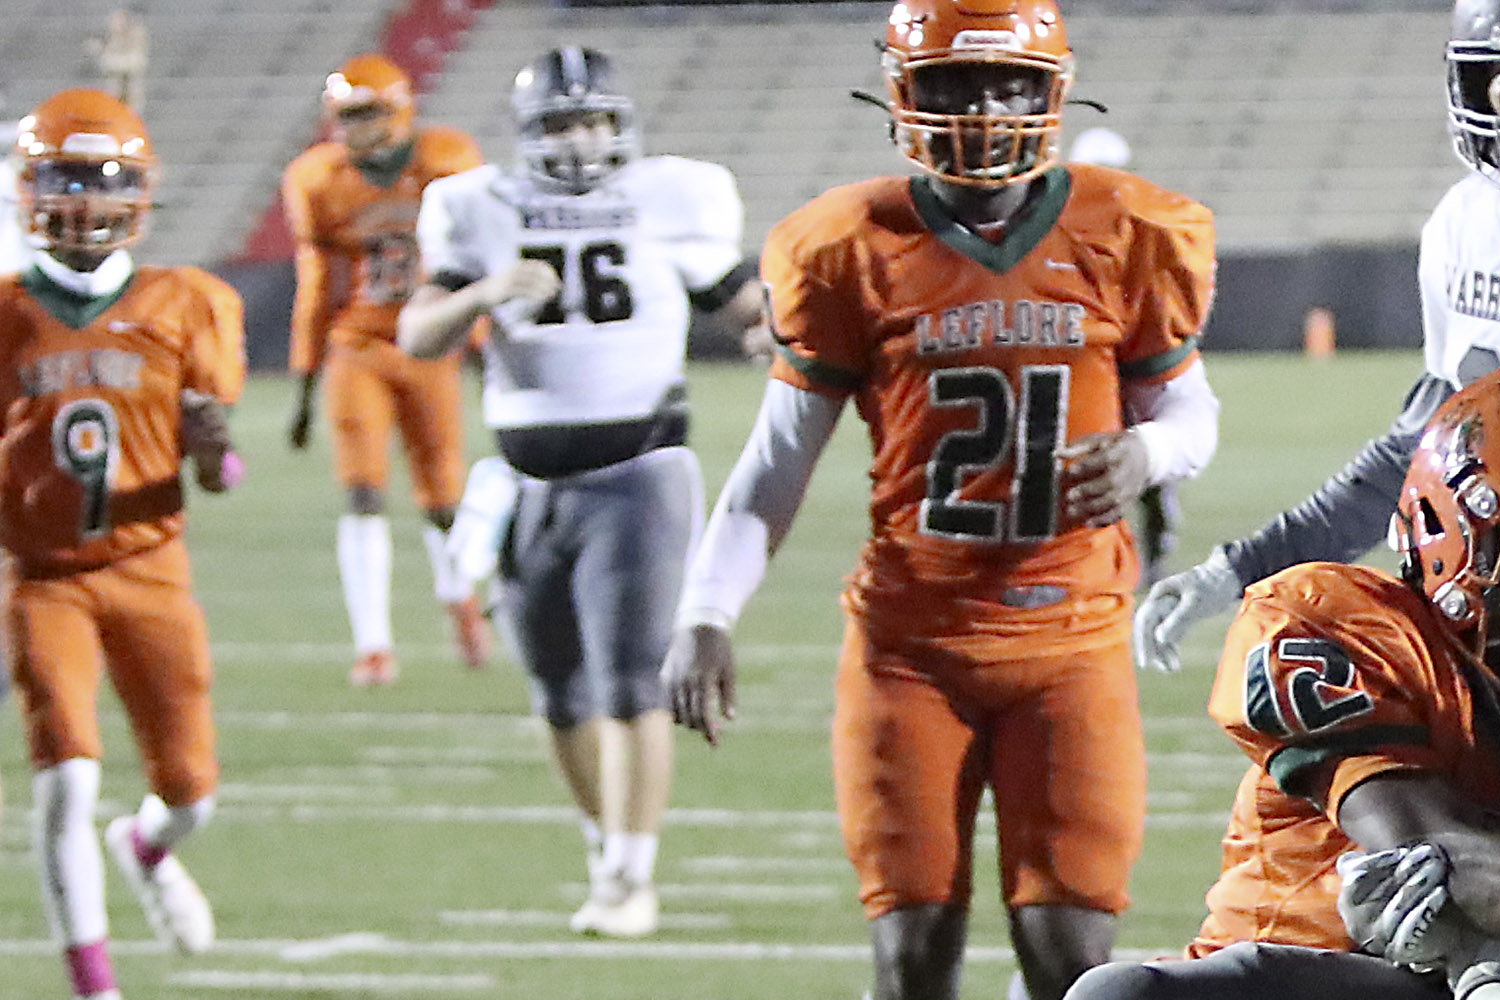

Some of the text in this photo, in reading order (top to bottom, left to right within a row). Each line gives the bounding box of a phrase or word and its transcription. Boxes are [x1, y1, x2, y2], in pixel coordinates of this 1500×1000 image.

[520, 243, 634, 325] 76
[916, 299, 1086, 355] LEFLORE
[52, 398, 121, 541] 9
[919, 365, 1070, 544] 21
[1244, 637, 1375, 739] 12
